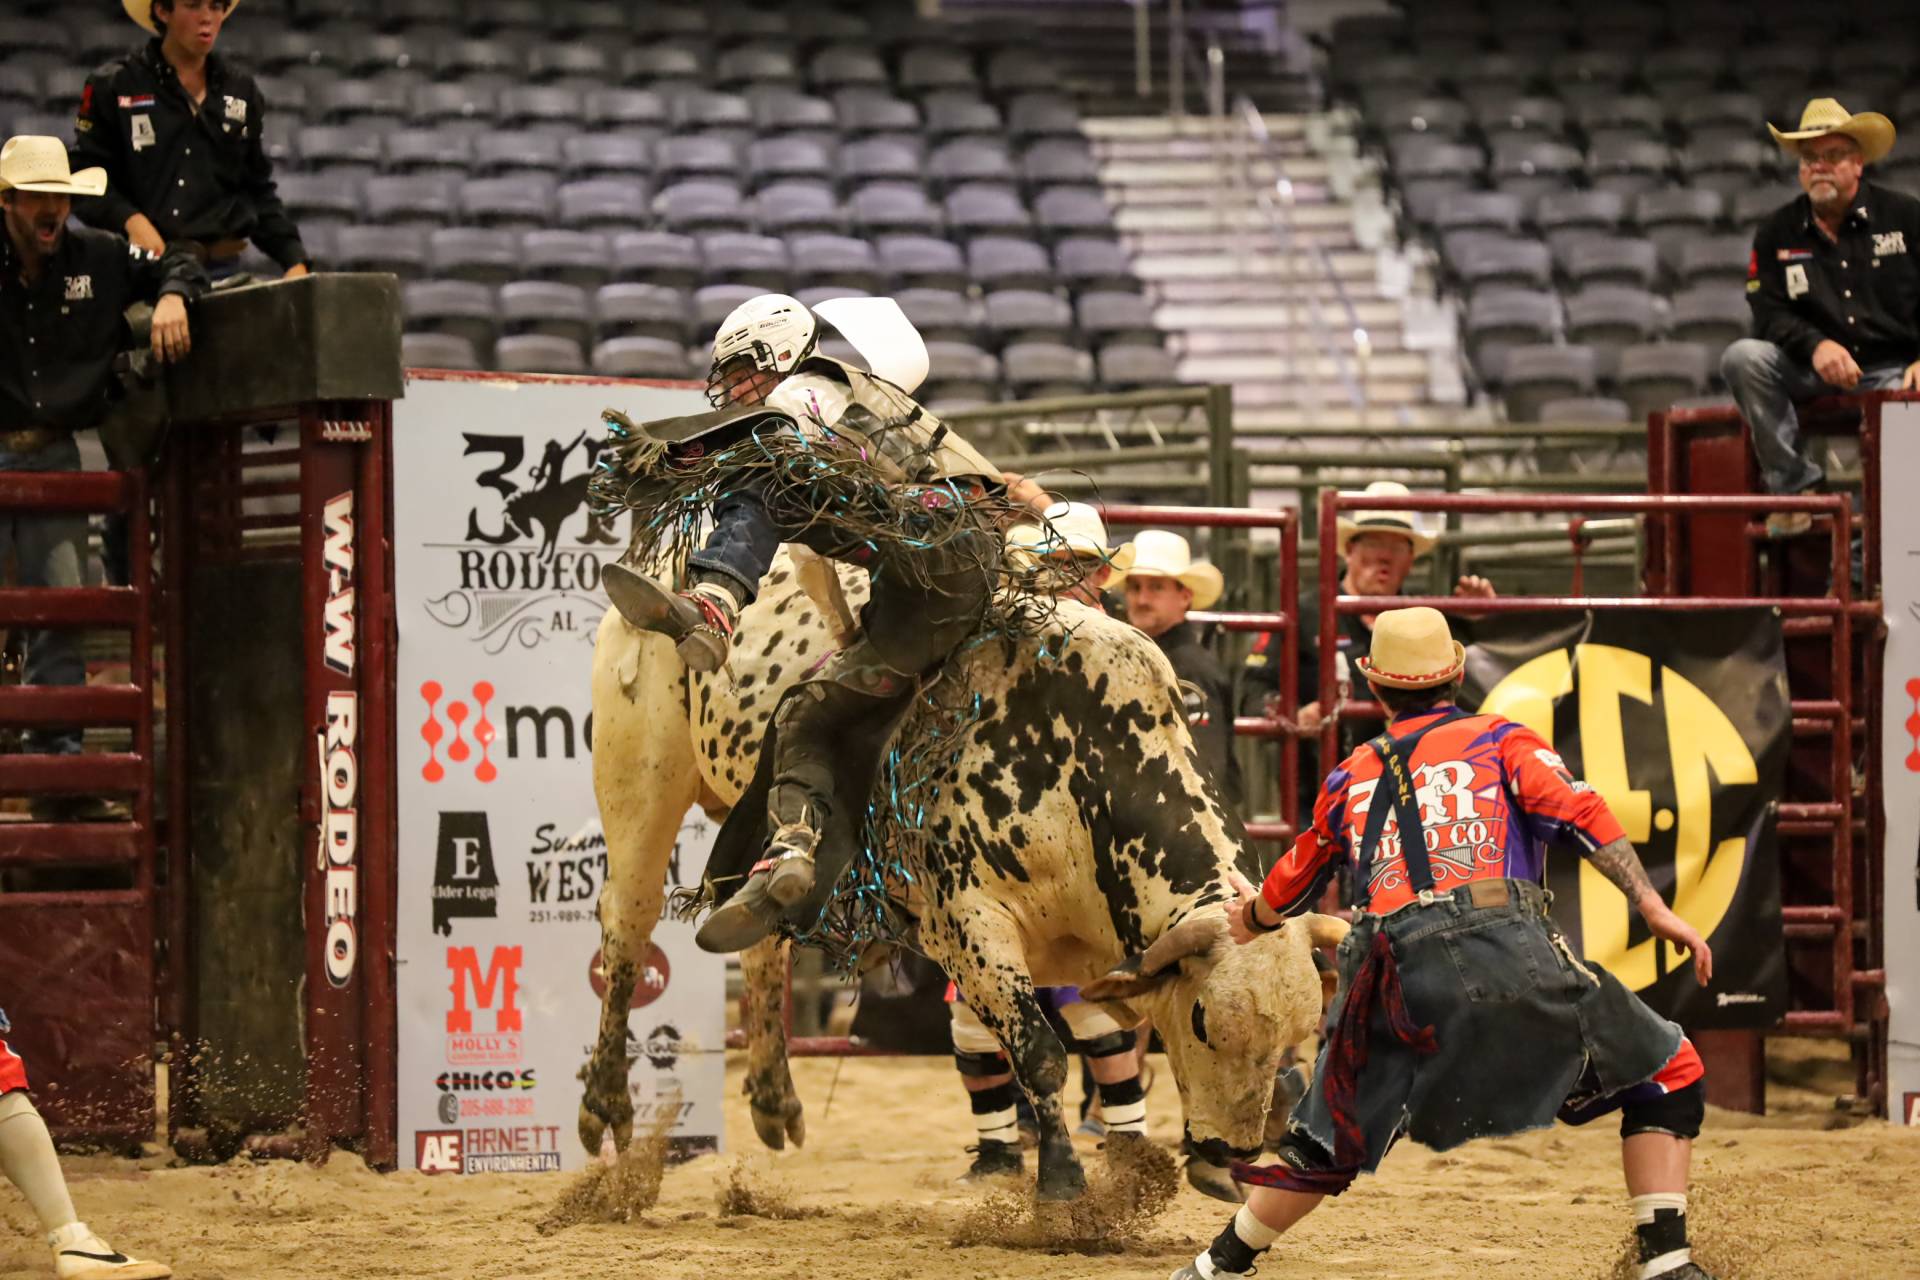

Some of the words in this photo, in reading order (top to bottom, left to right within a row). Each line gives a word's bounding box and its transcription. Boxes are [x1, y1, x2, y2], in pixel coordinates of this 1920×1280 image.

[323, 490, 354, 676] W-W
[458, 550, 600, 591] RODEO
[551, 611, 578, 632] AL
[326, 691, 357, 988] RODEO
[1450, 821, 1495, 847] CO.
[452, 838, 481, 880] E
[446, 945, 523, 1033] M
[421, 1135, 460, 1170] AE
[466, 1126, 560, 1153] ARNETT
[468, 1154, 560, 1173] ENVIRONMENTAL
